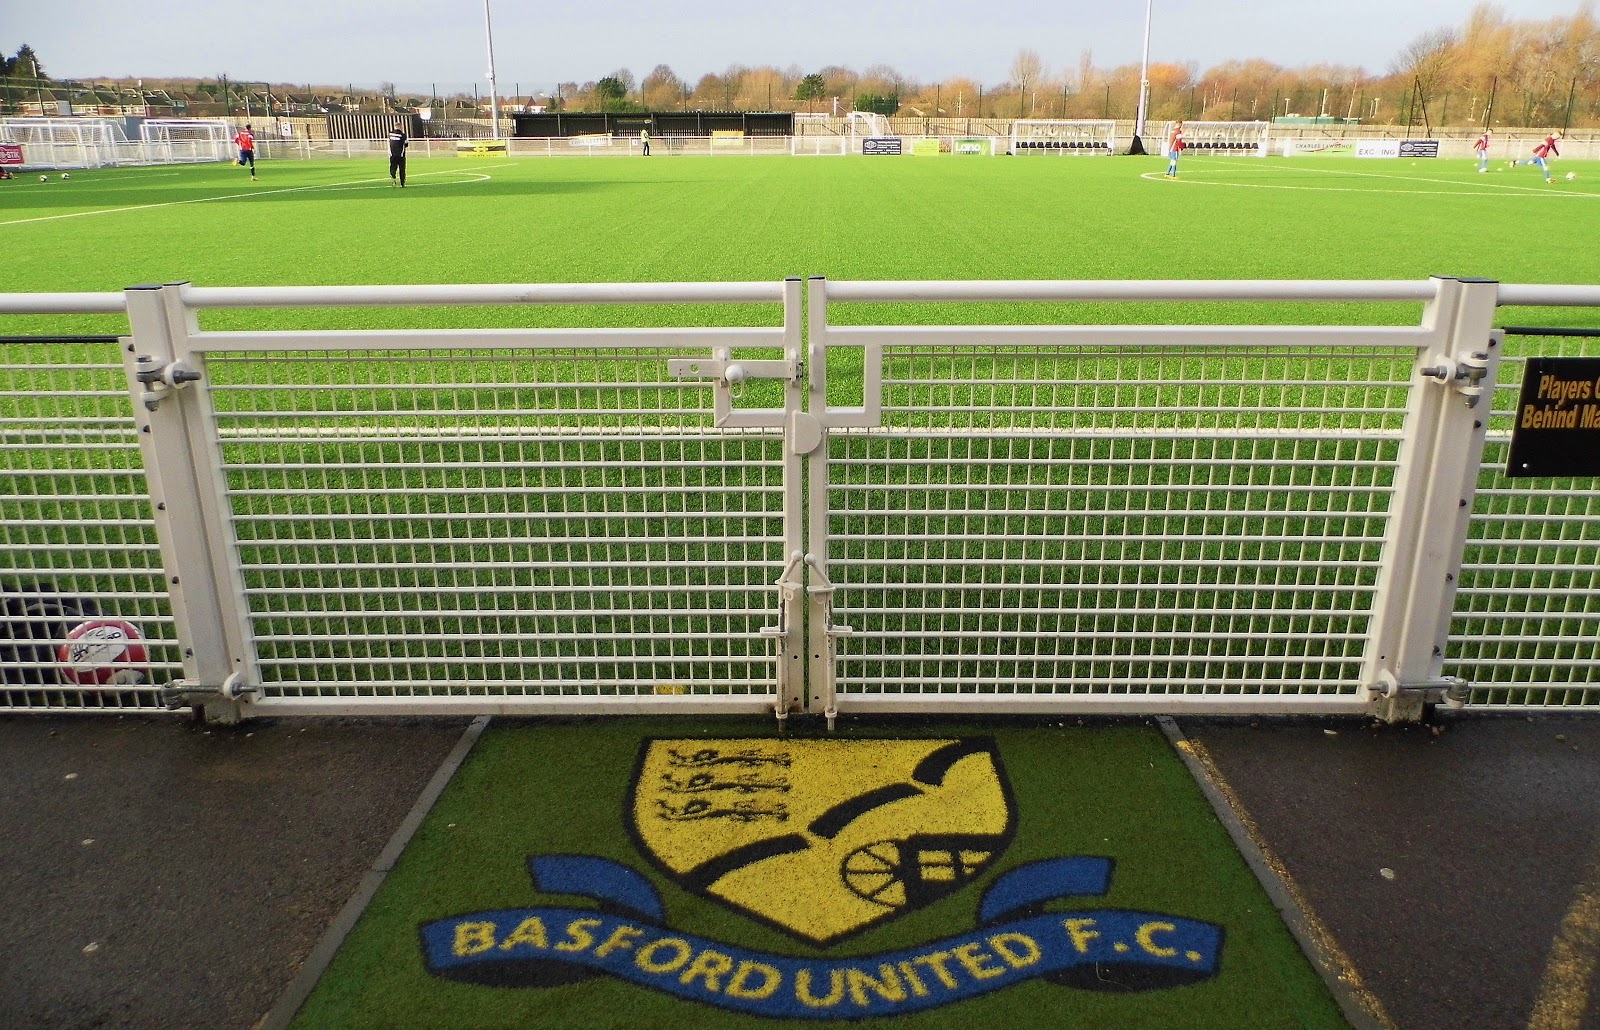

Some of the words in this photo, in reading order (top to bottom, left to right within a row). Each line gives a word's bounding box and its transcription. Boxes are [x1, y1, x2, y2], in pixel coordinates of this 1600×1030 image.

[1358, 148, 1396, 156] EXCING
[1538, 374, 1592, 406] Players
[1521, 404, 1579, 429] Behind
[452, 917, 782, 999] BASFORD
[795, 932, 1042, 1008] UNITED
[1062, 918, 1201, 962] F.C.
